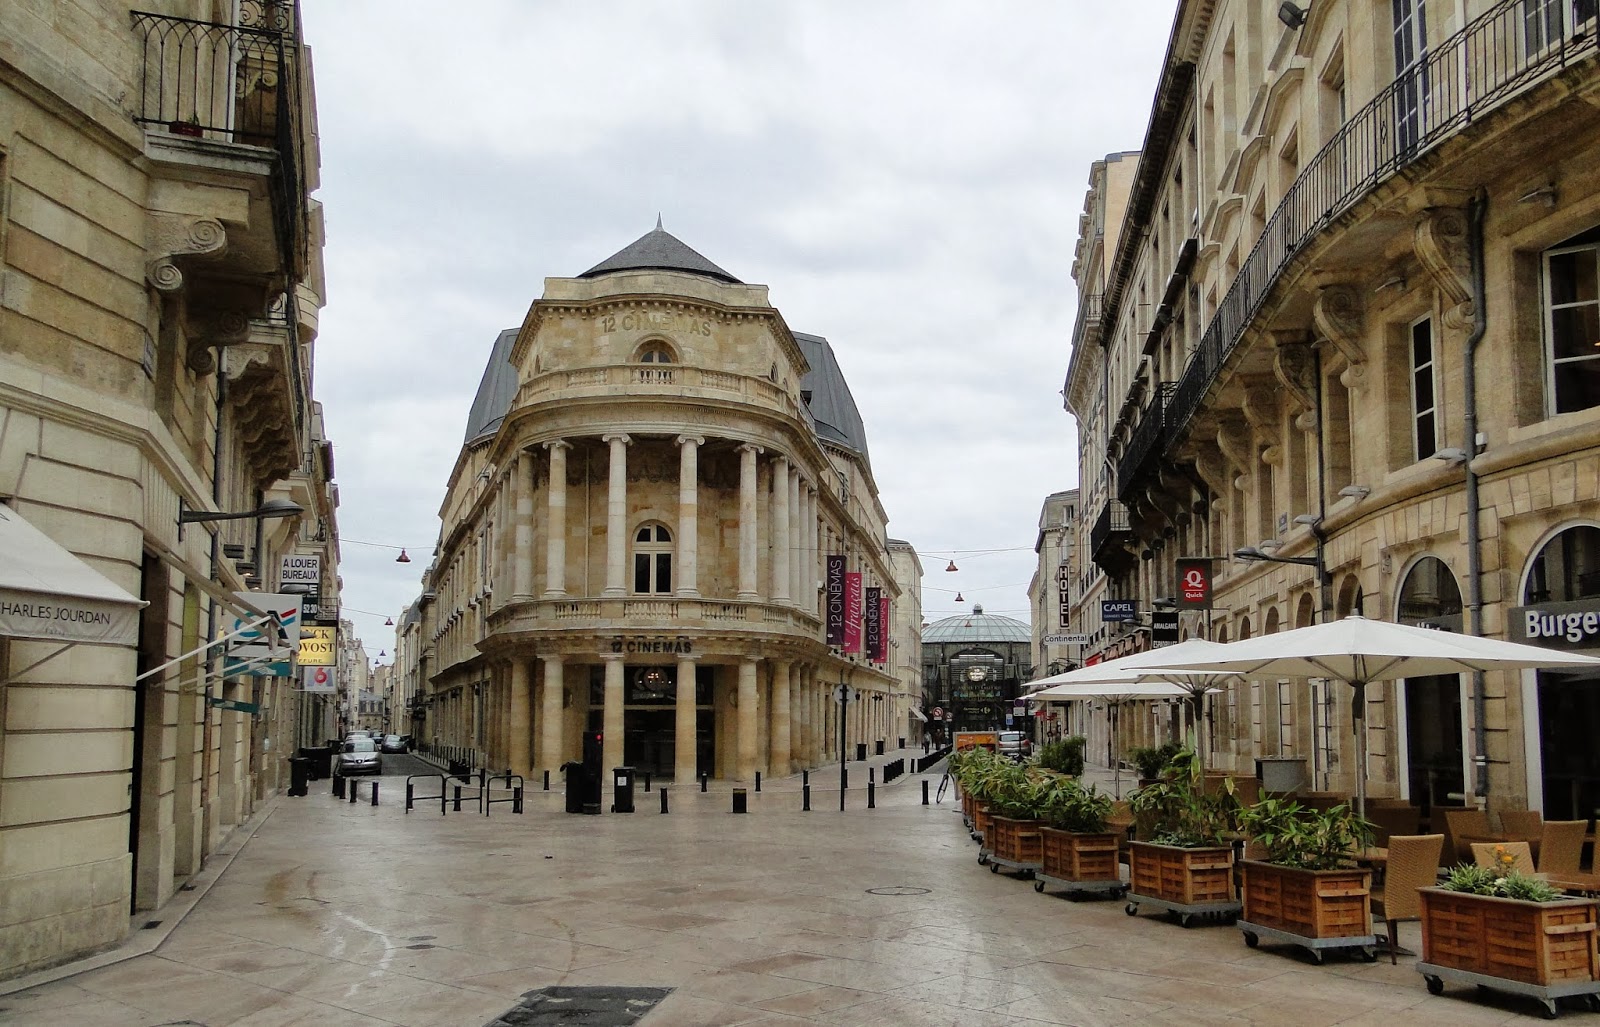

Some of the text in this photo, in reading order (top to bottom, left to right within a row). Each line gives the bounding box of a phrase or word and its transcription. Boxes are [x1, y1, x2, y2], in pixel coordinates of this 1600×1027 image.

[602, 317, 616, 333] 12
[283, 559, 317, 568] A LOUER
[283, 570, 318, 580] BUREAUX
[1060, 567, 1069, 626] HOTEL
[0, 601, 111, 625] HARLES JOURDAN
[1103, 603, 1134, 611] CAPEL
[832, 614, 842, 627] 12
[1525, 610, 1600, 643] Burge
[869, 634, 878, 645] 12
[1044, 634, 1087, 643] Continental
[611, 641, 692, 653] 12 CINEMAS
